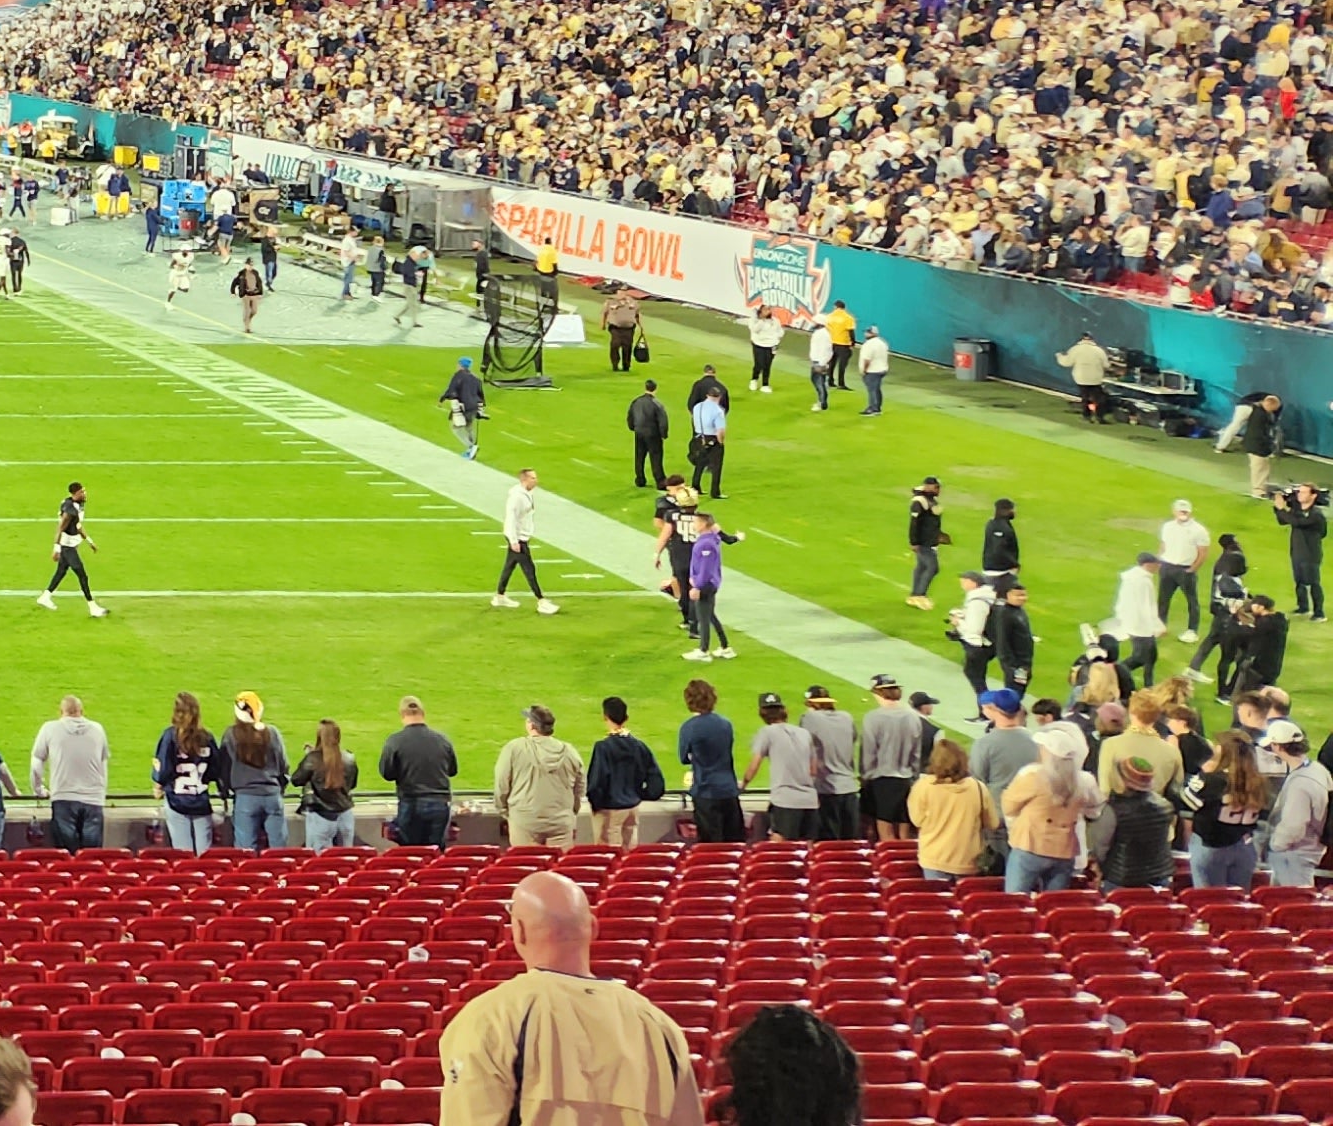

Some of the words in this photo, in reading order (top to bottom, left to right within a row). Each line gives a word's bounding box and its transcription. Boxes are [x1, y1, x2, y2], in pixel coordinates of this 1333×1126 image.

[613, 223, 686, 281] BOWL
[745, 264, 815, 314] GASPARILLA
[761, 289, 798, 314] BOWL
